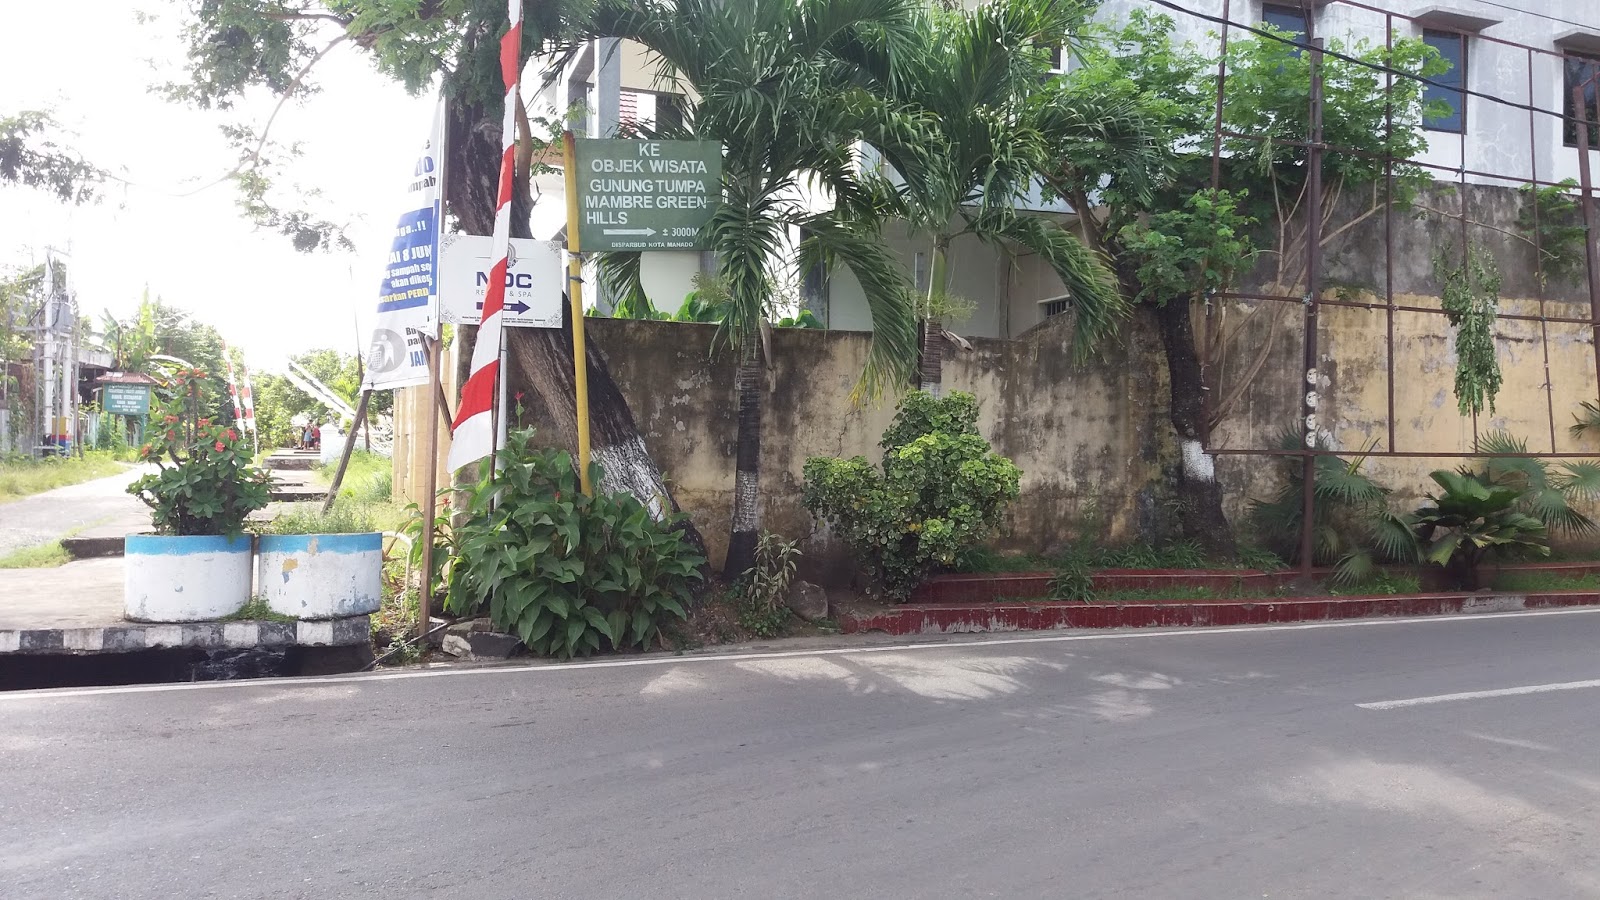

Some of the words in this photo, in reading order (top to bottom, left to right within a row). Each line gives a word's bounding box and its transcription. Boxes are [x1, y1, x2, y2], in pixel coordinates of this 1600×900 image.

[638, 143, 661, 157] KE
[591, 159, 644, 173] OBJEK
[649, 160, 708, 174] WISATA
[590, 179, 653, 193] GUNUNG
[655, 179, 706, 193] TUMPA
[585, 195, 653, 209] MAMBRE
[656, 196, 707, 209] GREEN
[586, 211, 628, 225] HILLS
[671, 227, 700, 237] 3000M
[391, 263, 420, 277] sampah
[391, 277, 409, 288] akan
